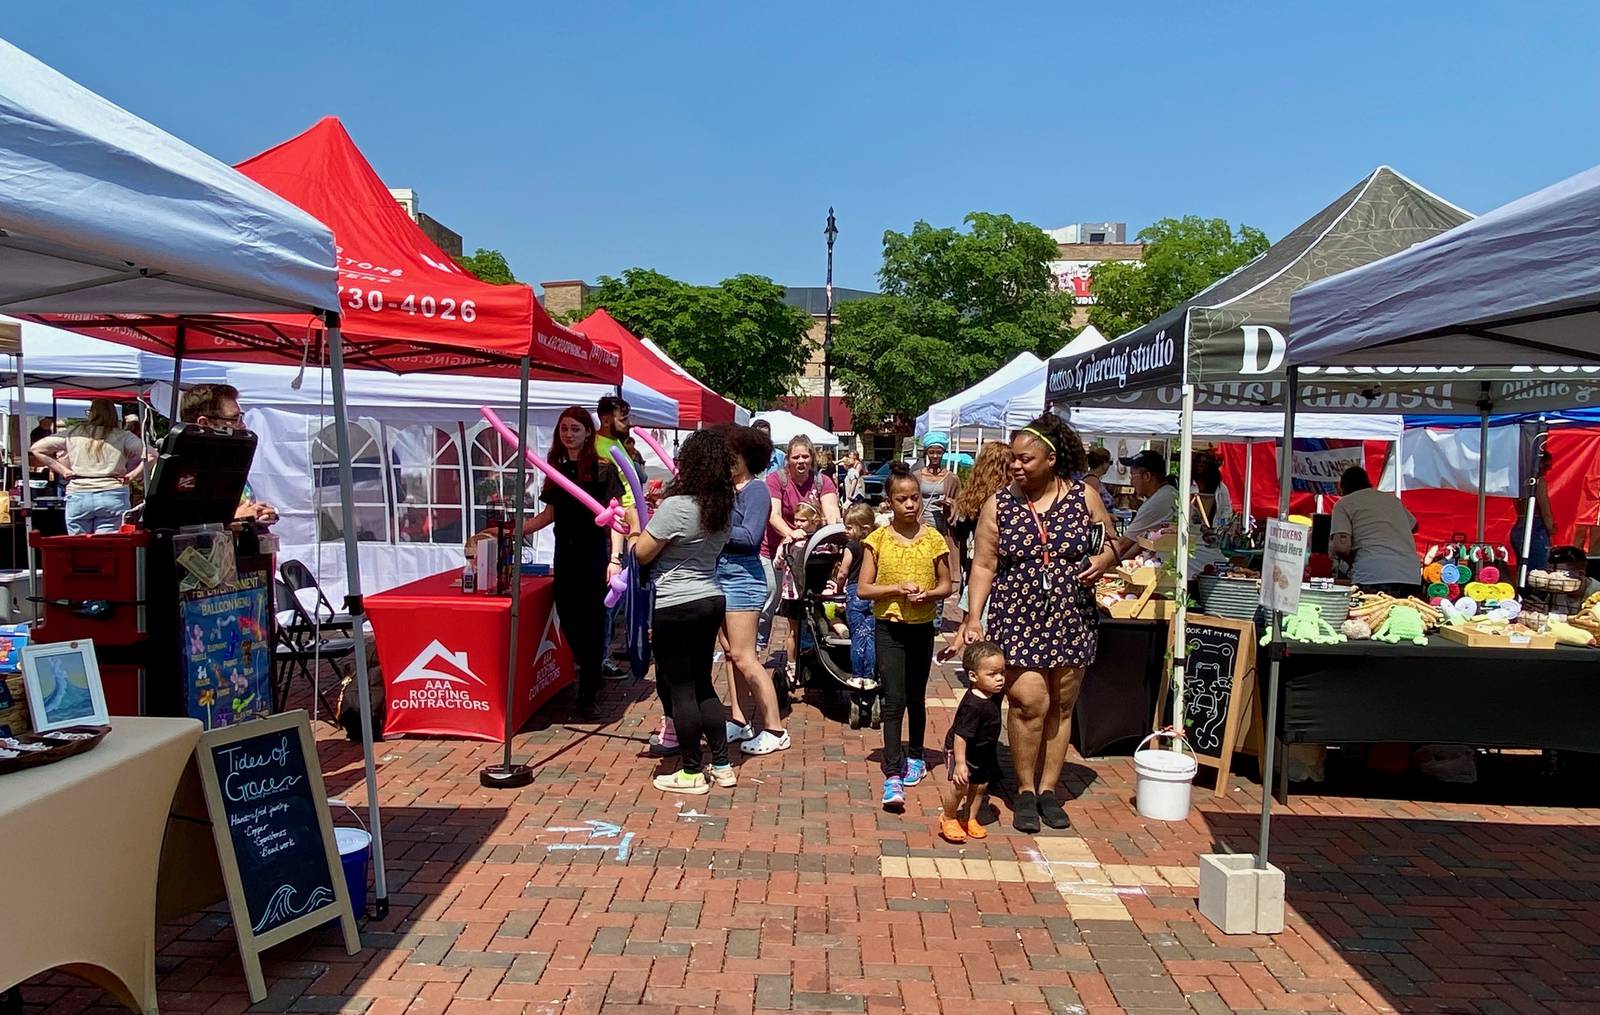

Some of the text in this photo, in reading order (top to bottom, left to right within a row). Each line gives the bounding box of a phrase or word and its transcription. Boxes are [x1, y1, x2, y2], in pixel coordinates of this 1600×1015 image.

[1050, 368, 1074, 392] tattoo
[1083, 346, 1129, 393] piercing
[1130, 330, 1175, 375] studio
[1202, 628, 1213, 636] AT
[424, 680, 453, 690] AAA
[409, 689, 470, 701] ROOFING
[391, 699, 490, 711] CONTRACTORS
[218, 736, 291, 773] Tides of
[225, 772, 302, 802] Grace
